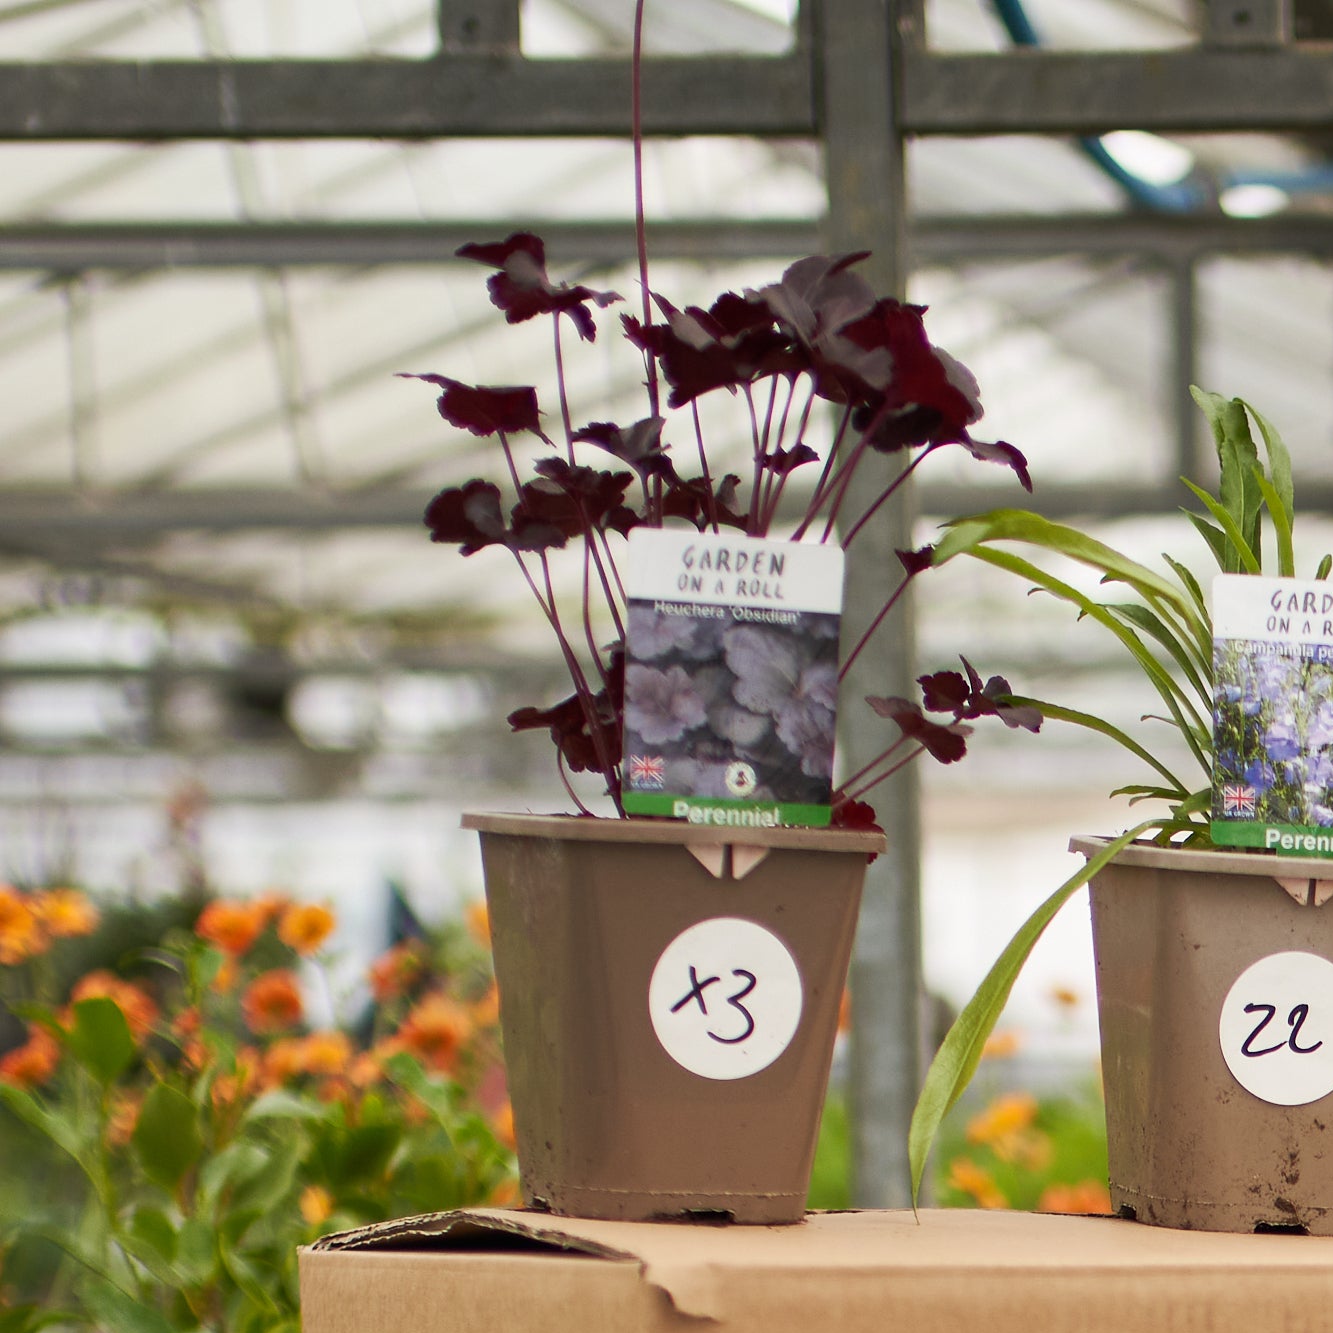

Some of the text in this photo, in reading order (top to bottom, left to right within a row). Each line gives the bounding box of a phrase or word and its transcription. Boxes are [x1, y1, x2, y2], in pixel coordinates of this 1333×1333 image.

[681, 544, 785, 577] GARDEN
[677, 573, 785, 600] ON A ROLL
[653, 600, 725, 619] Heuchera
[1266, 616, 1290, 633] ON
[1302, 619, 1311, 634] A
[1234, 640, 1315, 659] Campanula
[673, 800, 780, 826] Perennial
